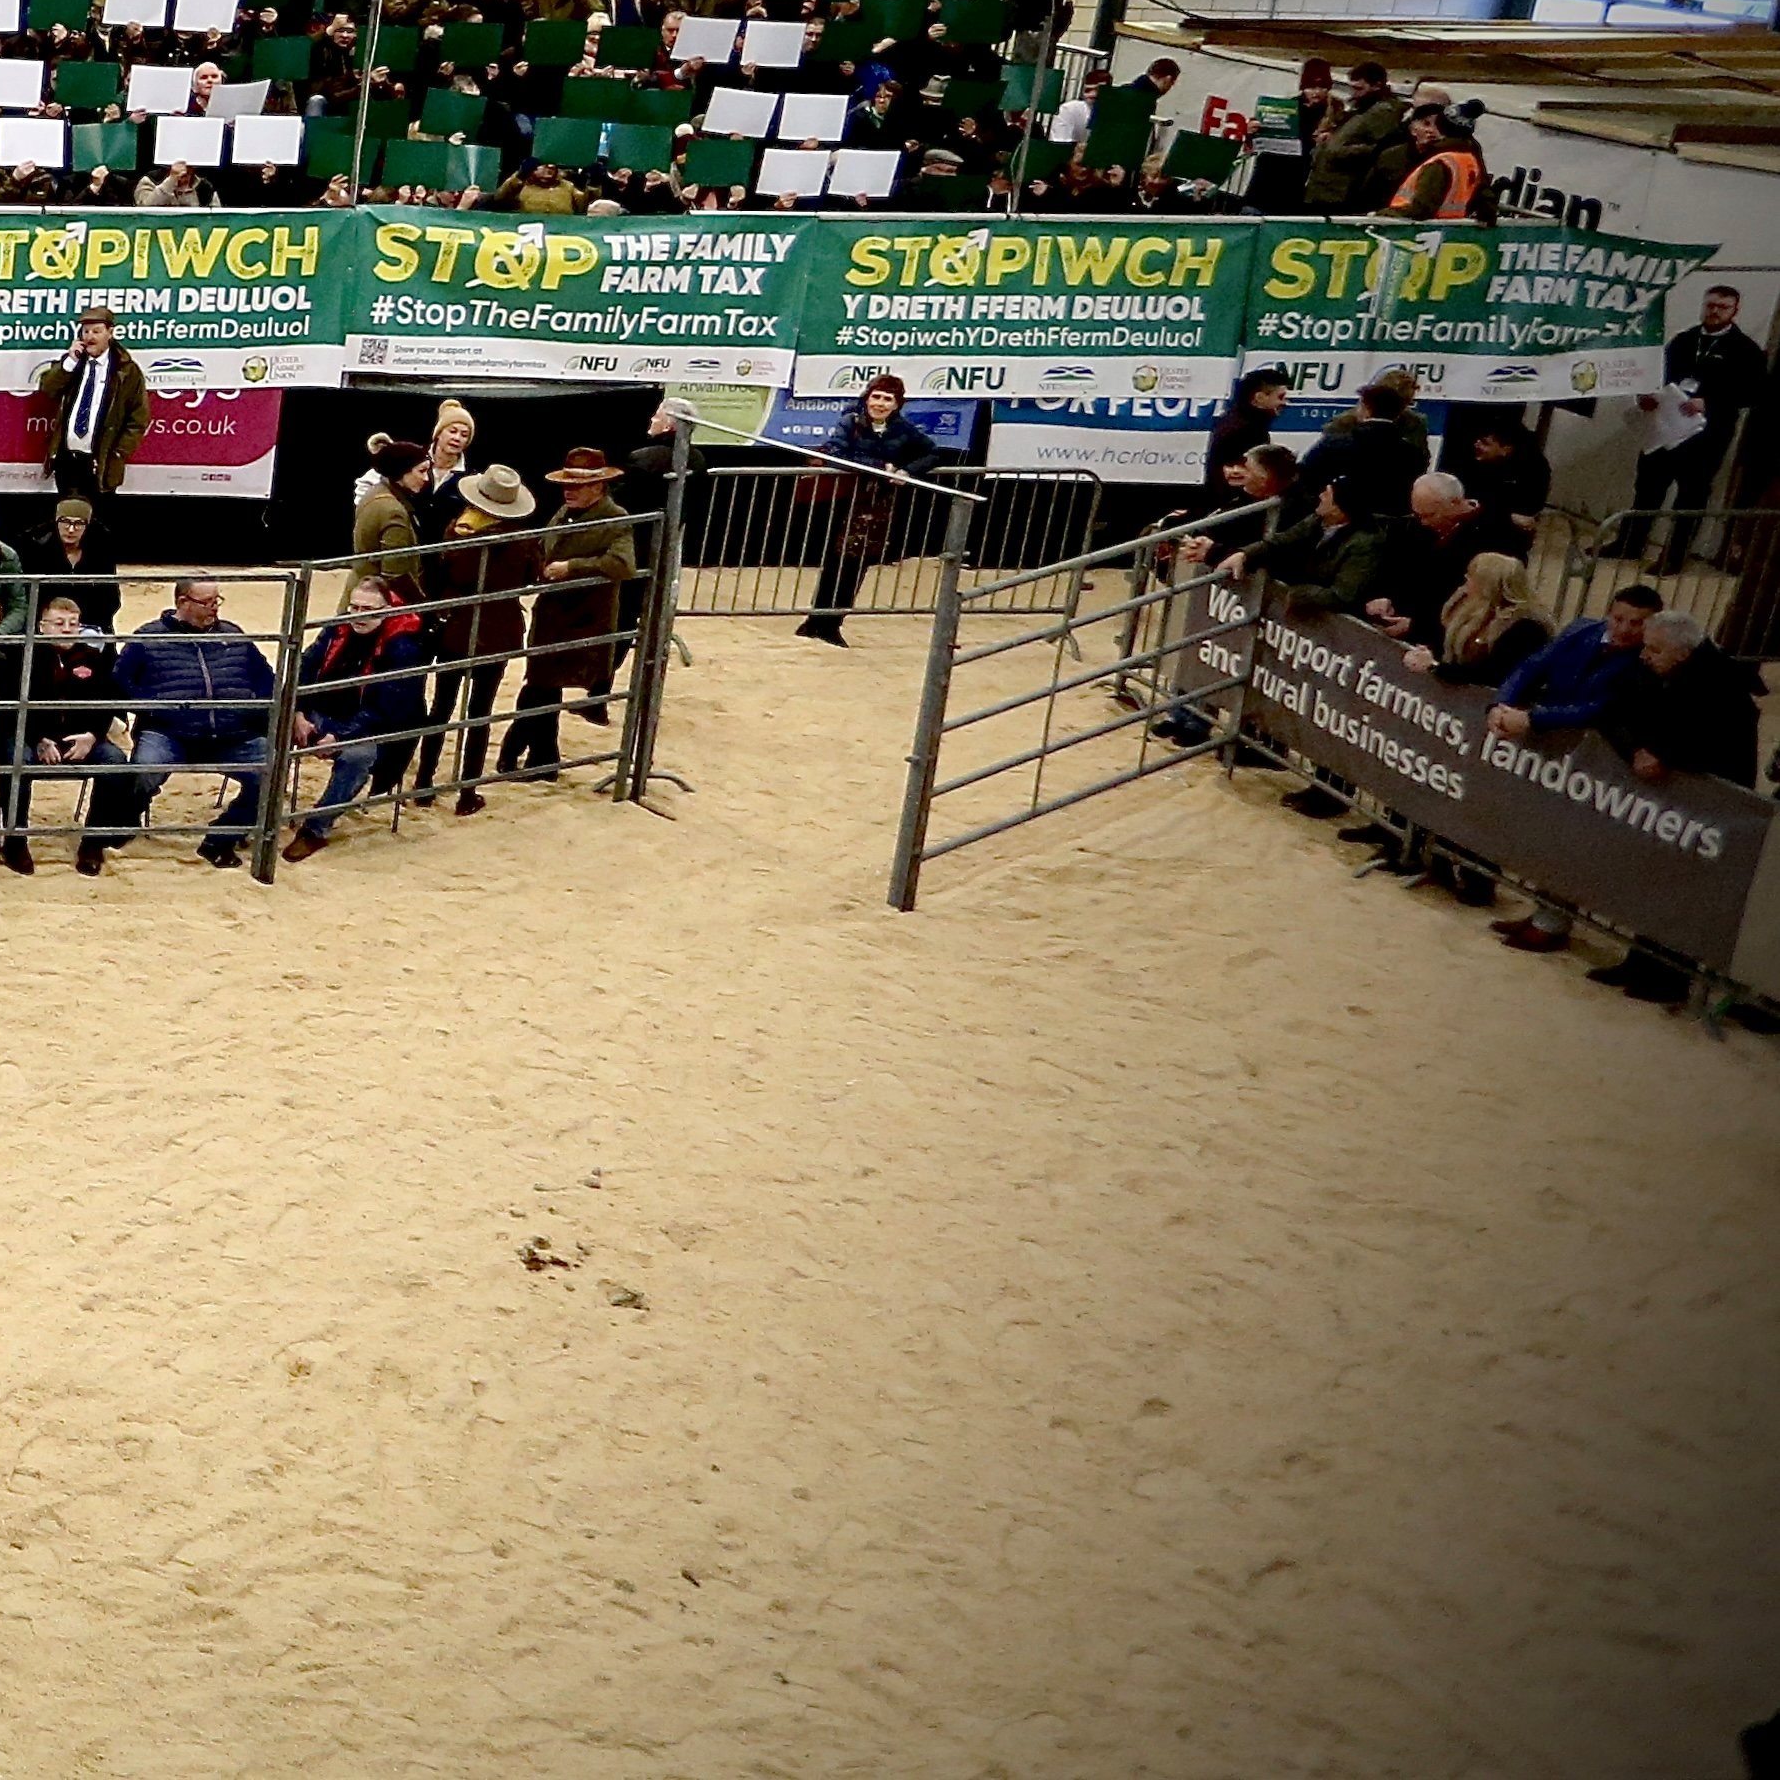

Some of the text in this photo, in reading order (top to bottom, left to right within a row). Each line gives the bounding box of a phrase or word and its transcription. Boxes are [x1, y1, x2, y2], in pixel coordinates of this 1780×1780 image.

[372, 222, 599, 291] STOP
[603, 234, 797, 262] THE FAMILY
[844, 232, 1224, 287] STOPIWCH
[1498, 242, 1704, 286] THE FAMILY
[600, 265, 766, 296] FARM TAX
[1486, 275, 1661, 314] FARM TAX
[79, 288, 168, 313] FFERM
[176, 285, 312, 314] DEULUOL
[842, 294, 1206, 321] Y DRETH FFERM DEULUOL
[369, 295, 779, 341] #StopTheFamilyFarmTax
[835, 325, 1201, 351] #StopiwchYDrethFfermDeuluol
[579, 356, 618, 371] NFU
[646, 358, 671, 369] NFU
[946, 366, 1006, 390] NFU
[1249, 661, 1310, 717] rural
[1311, 700, 1466, 803] businesses
[1355, 658, 1471, 755] farmers,
[1483, 729, 1725, 861] landowners
